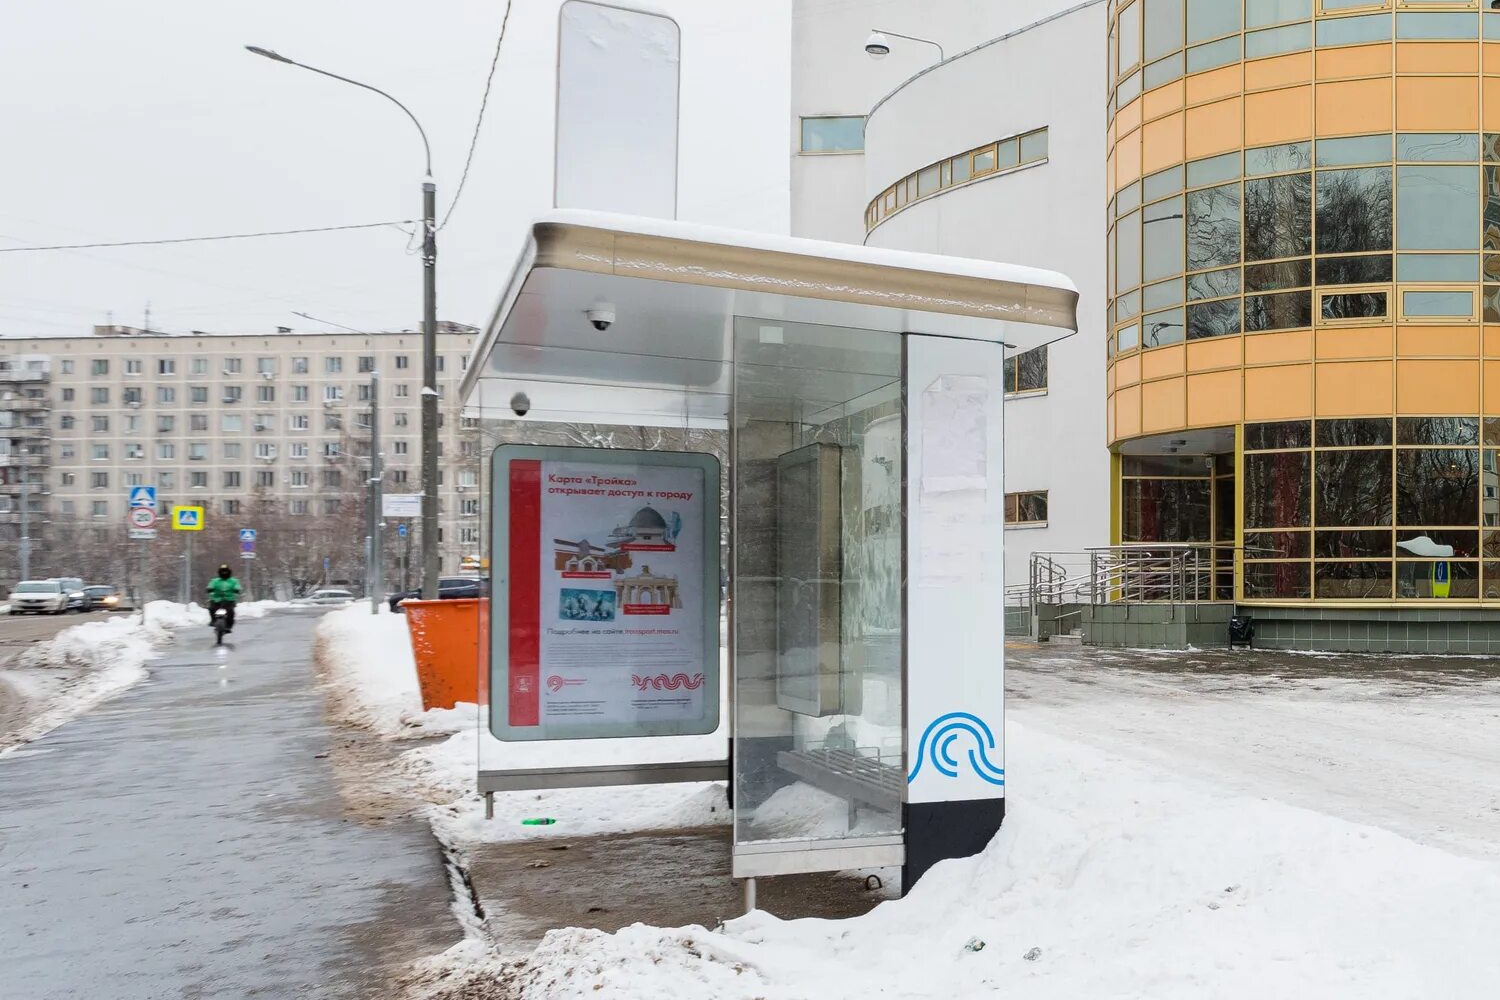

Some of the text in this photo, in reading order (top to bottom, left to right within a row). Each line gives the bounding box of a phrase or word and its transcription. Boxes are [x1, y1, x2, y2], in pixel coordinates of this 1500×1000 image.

[548, 474, 637, 487] Карта «Тройка»
[548, 487, 606, 498] открывает
[608, 489, 644, 500] доступ
[655, 492, 694, 501] городу
